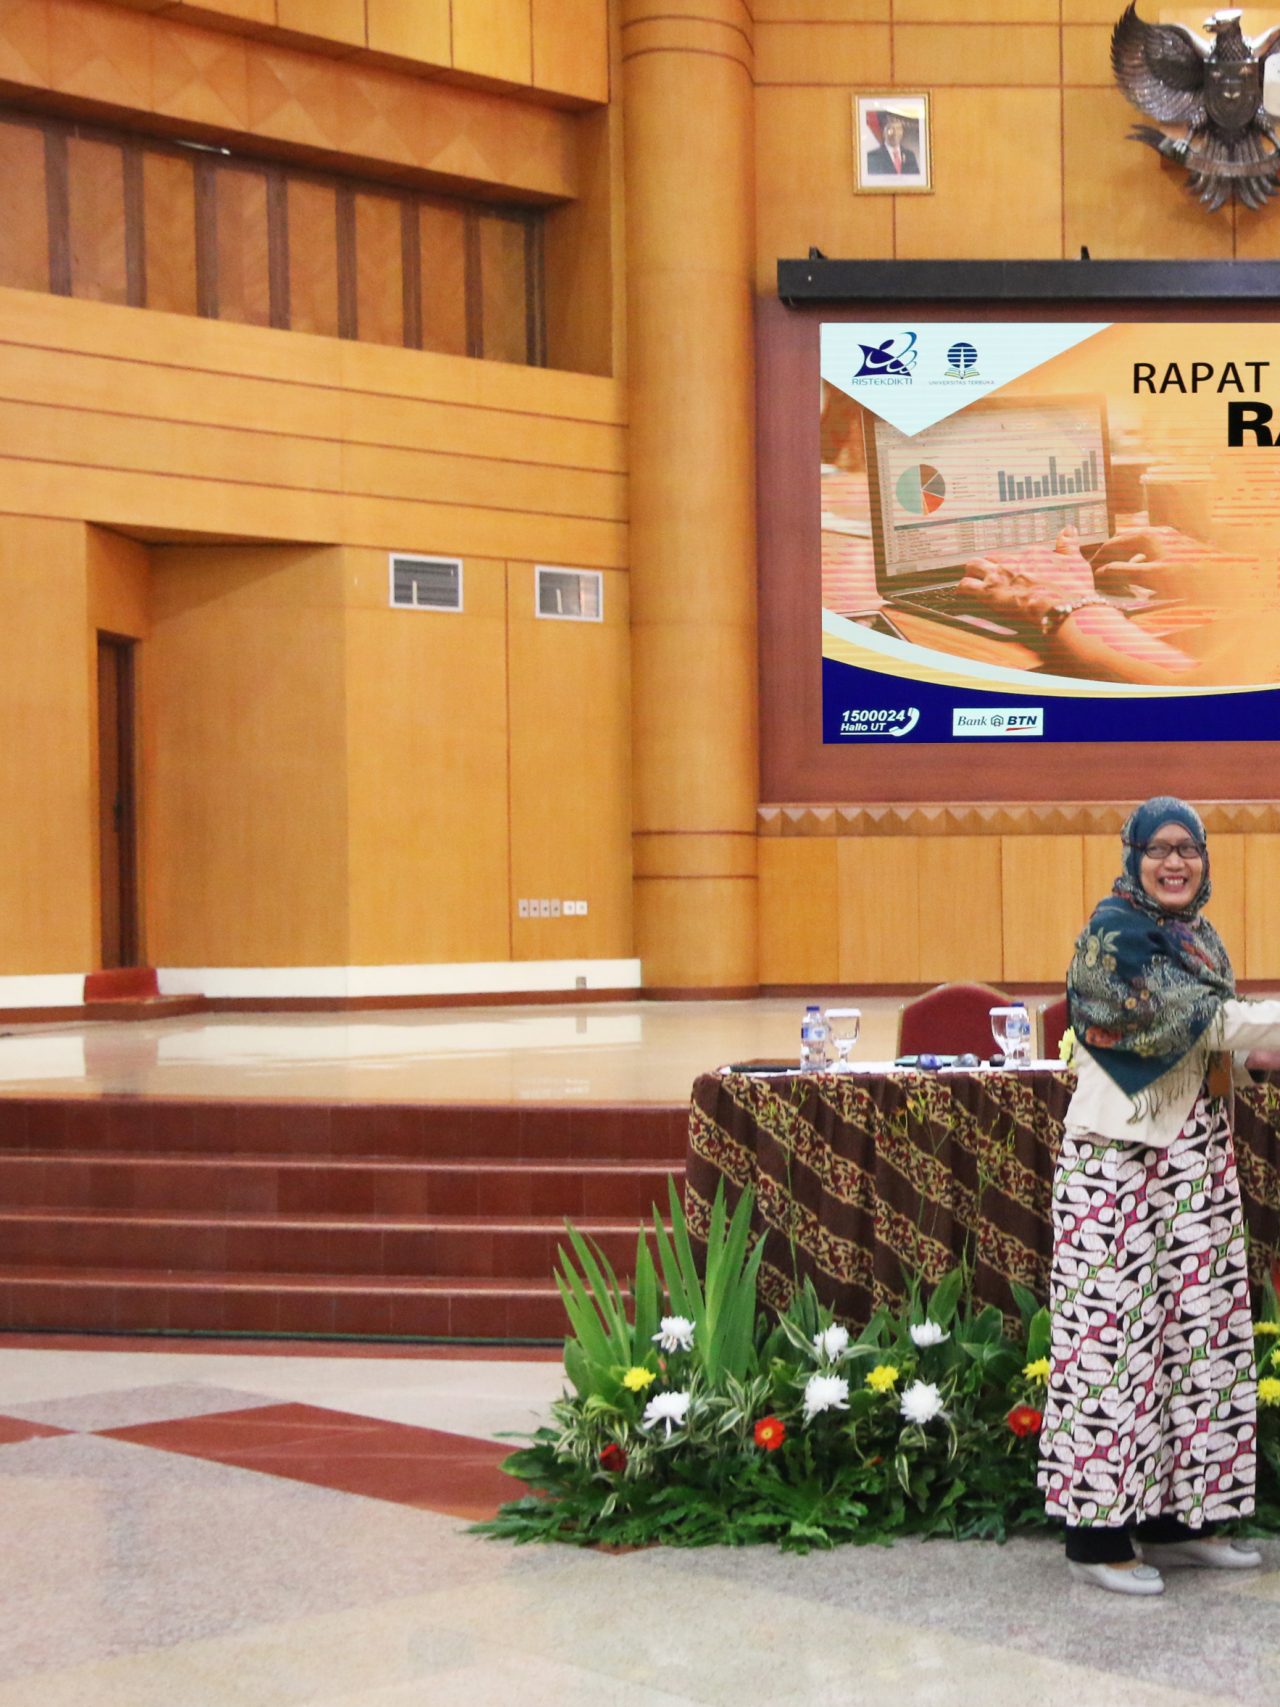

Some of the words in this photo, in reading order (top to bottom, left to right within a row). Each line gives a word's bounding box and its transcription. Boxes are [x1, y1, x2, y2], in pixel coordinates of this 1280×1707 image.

[851, 377, 913, 386] RISTEKDIKTI
[1132, 361, 1269, 394] RAPAT
[842, 709, 906, 722] 1500024
[957, 715, 987, 727] Bank
[1007, 715, 1038, 726] BTN
[841, 723, 868, 732] Hallo
[871, 722, 887, 732] UT
